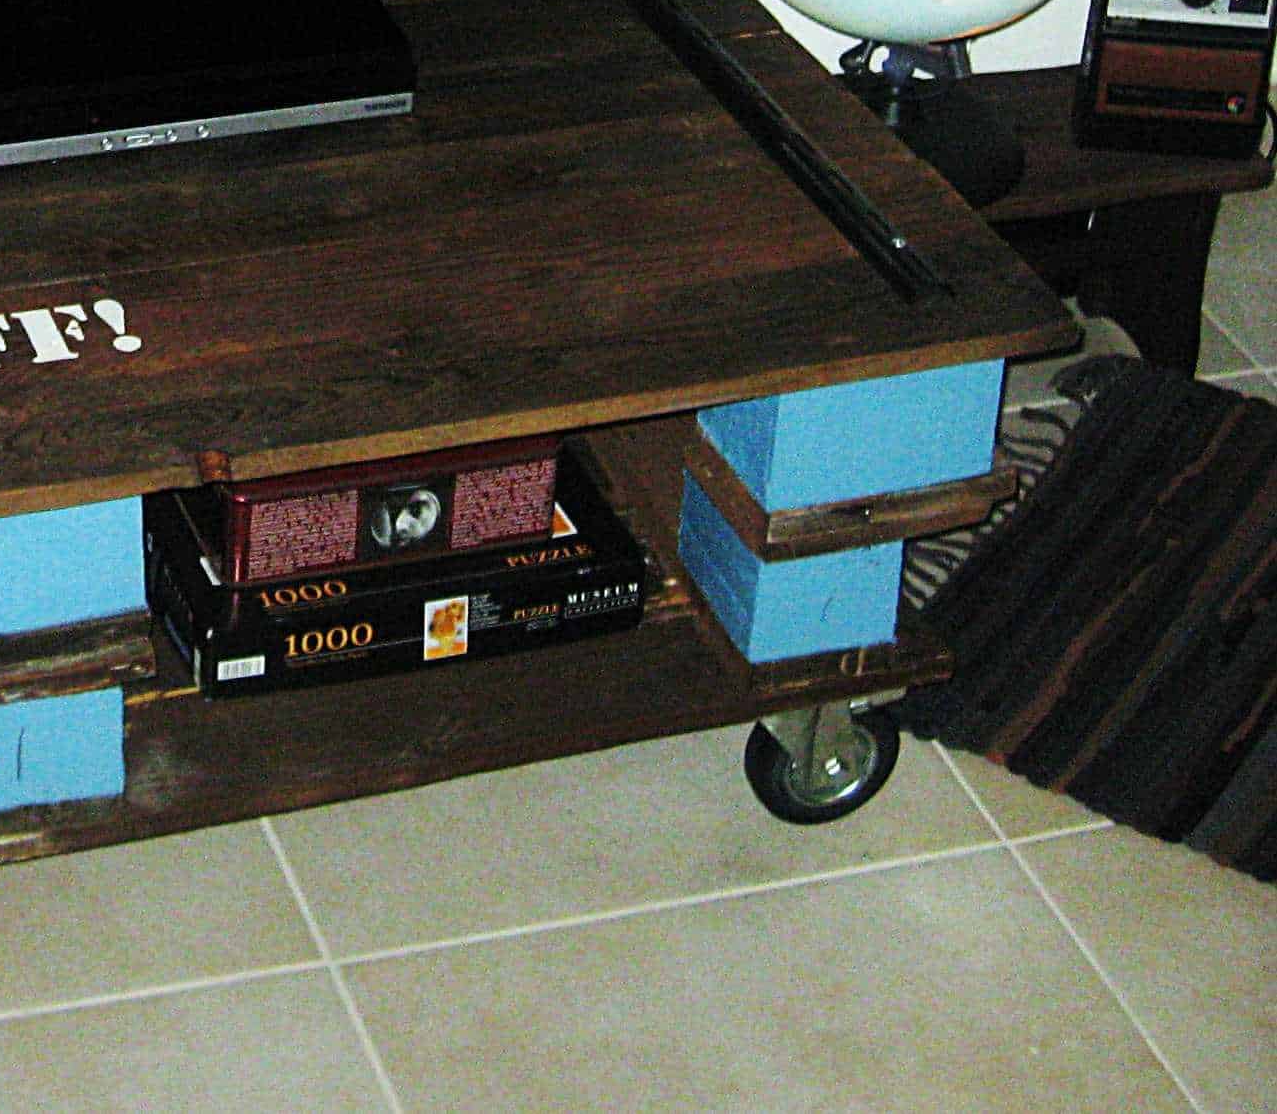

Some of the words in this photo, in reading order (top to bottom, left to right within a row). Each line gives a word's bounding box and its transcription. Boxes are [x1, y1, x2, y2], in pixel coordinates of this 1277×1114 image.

[507, 542, 593, 567] PUZZLE
[260, 581, 347, 607] 1000
[567, 582, 638, 603] MUSEUM
[285, 622, 373, 657] 1000
